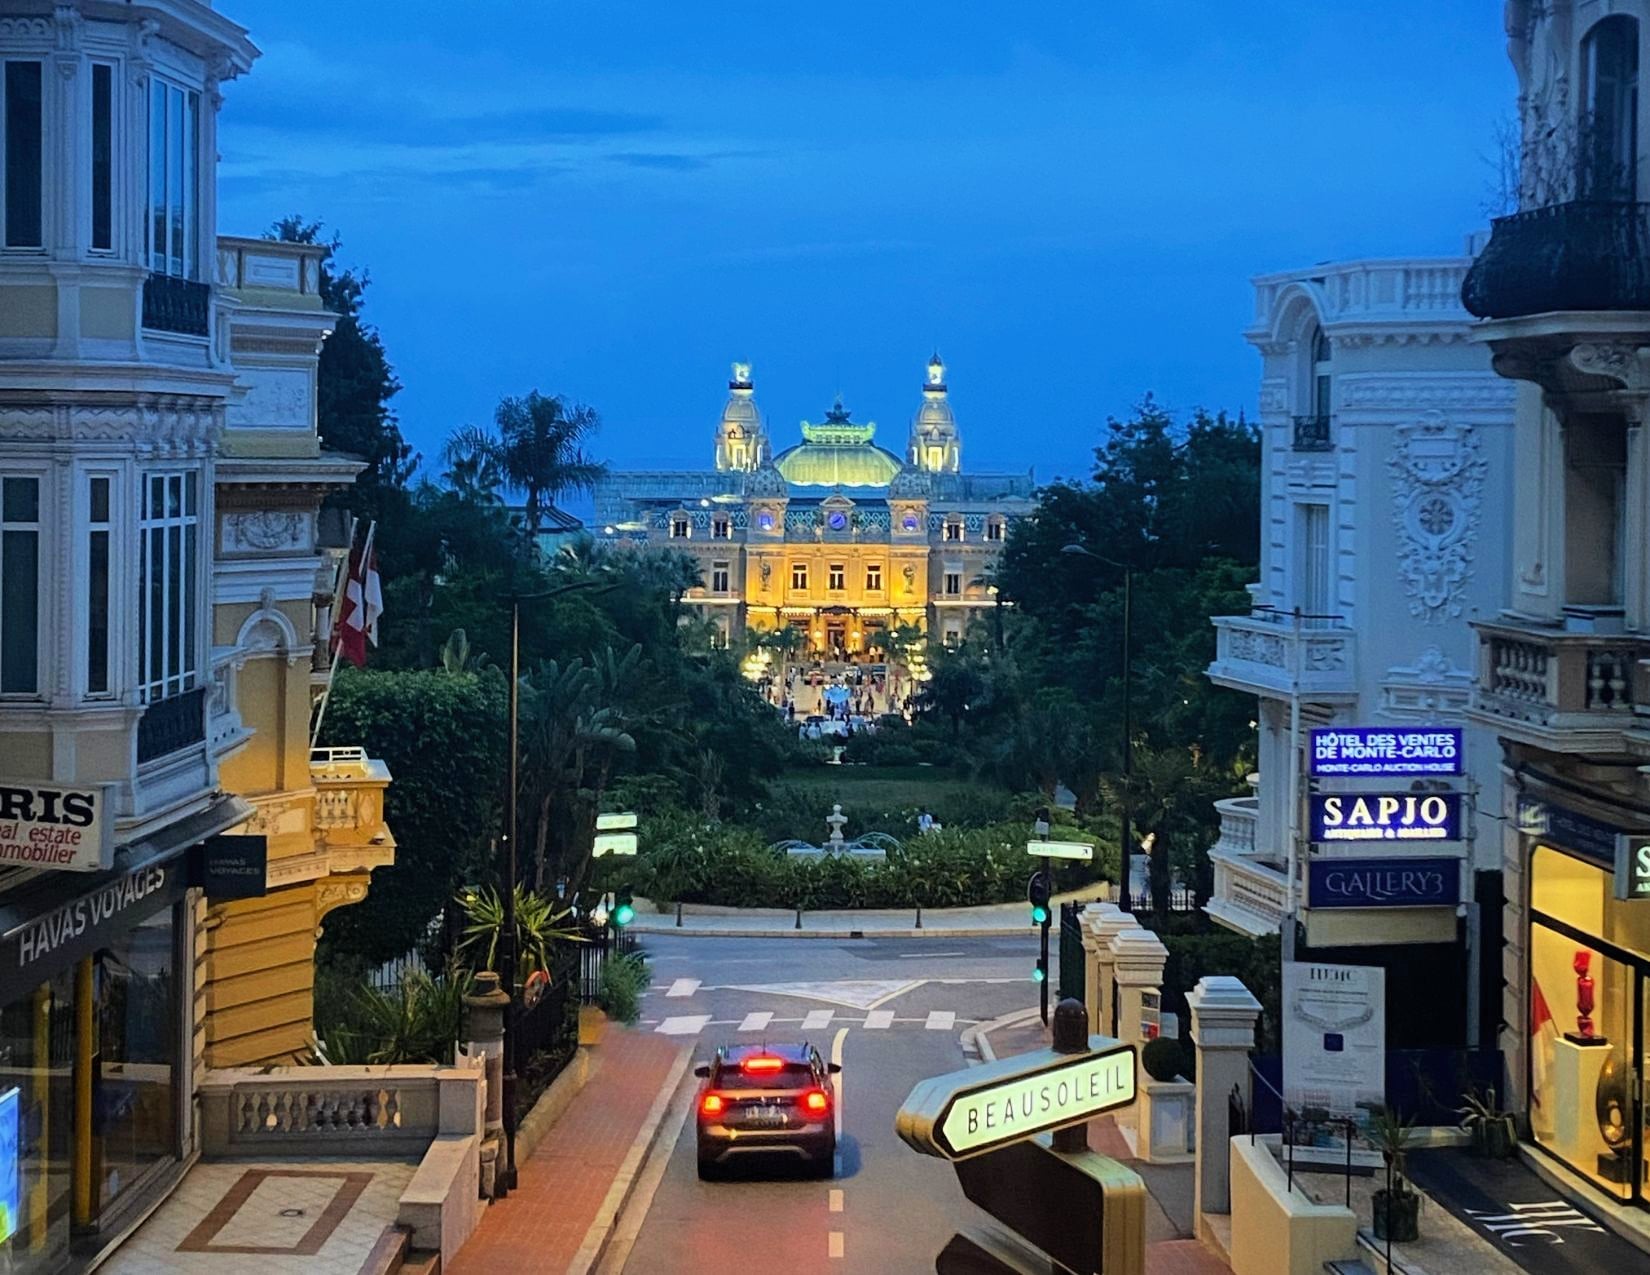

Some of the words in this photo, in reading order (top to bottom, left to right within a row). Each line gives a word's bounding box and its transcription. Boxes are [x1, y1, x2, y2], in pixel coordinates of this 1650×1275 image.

[1315, 732, 1363, 747] HÔTEL
[1366, 734, 1396, 746] DES
[1400, 733, 1455, 746] VENTES
[1315, 747, 1337, 759] DE
[1341, 746, 1456, 759] MONTE-CARLO
[1323, 796, 1448, 826] SAPJO
[28, 825, 82, 846] estate
[19, 900, 87, 967] HAVAS
[90, 867, 165, 926] VOYAGES
[967, 1065, 1125, 1135] BEAUSOLEIL
